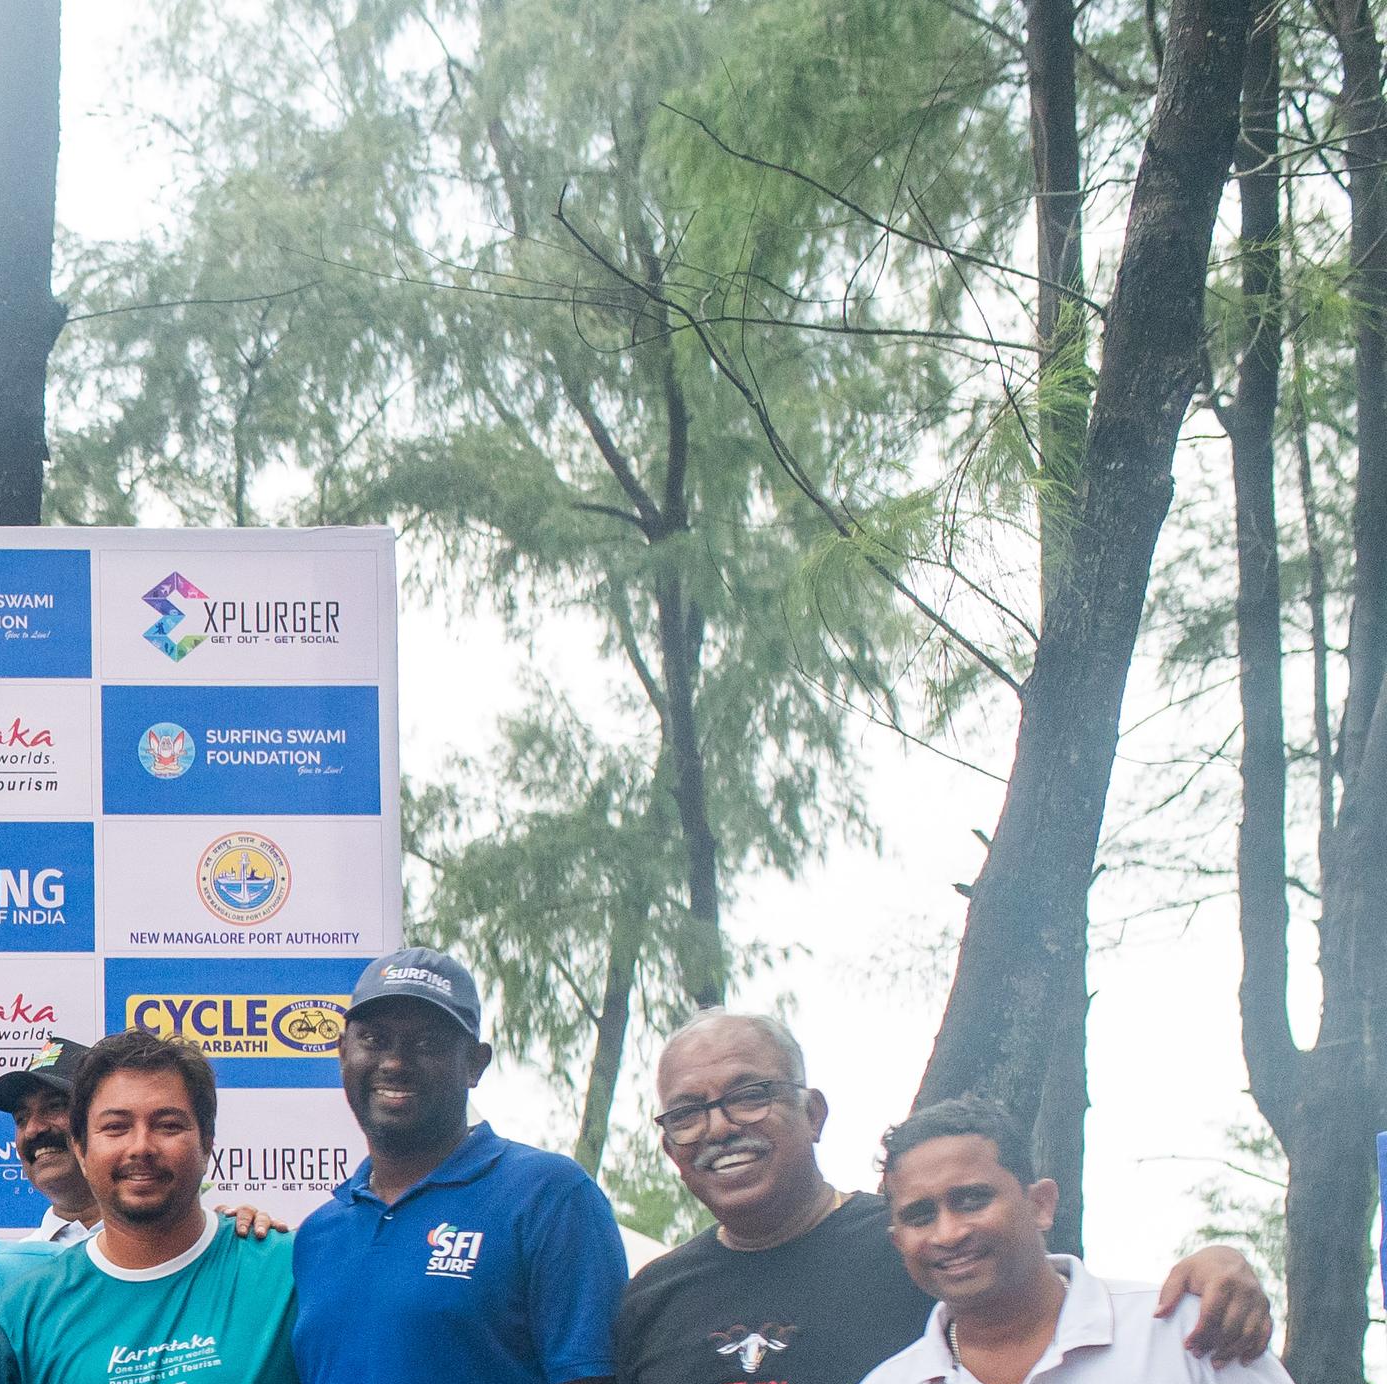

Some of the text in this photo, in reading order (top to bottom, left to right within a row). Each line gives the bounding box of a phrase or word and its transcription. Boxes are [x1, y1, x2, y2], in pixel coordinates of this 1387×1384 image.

[207, 730, 345, 744] SURFING SWAMI
[207, 751, 320, 764] FOUNDATION
[13, 910, 65, 924] INDIA
[130, 932, 359, 944] NEW MANGALORE PORT AUTHORITY
[131, 1000, 268, 1038] CYCLE
[432, 1229, 484, 1259] SFI
[428, 1256, 476, 1273] SURF
[107, 1334, 216, 1374] Karnataka
